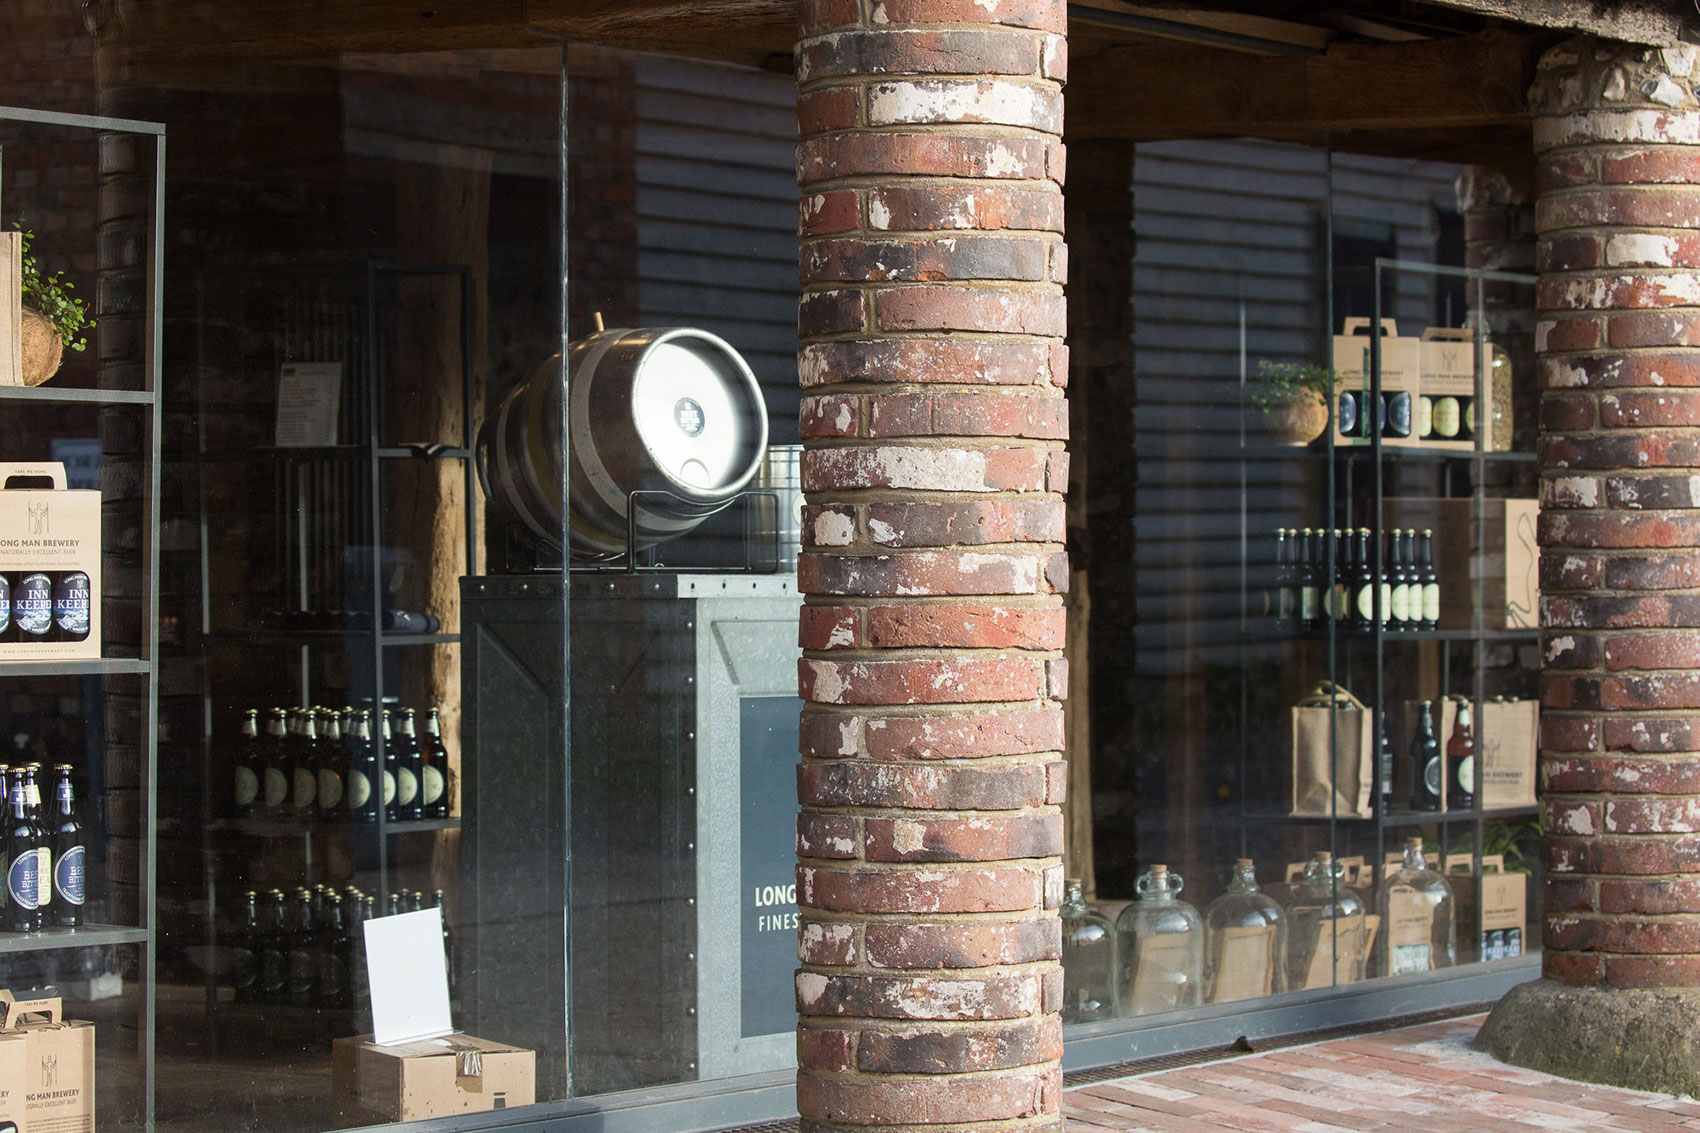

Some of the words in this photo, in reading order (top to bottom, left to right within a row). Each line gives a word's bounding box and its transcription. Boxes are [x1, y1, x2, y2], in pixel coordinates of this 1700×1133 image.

[0, 539, 19, 547] ONG
[21, 539, 41, 547] MAN
[43, 539, 80, 547] BREWERY
[28, 589, 49, 599] INN
[69, 589, 89, 599] INN
[16, 599, 52, 609] KEEPE
[23, 870, 38, 880] BES
[70, 866, 85, 875] BES
[755, 884, 797, 907] LONG
[758, 912, 799, 932] FINES
[36, 1092, 51, 1100] MAN
[52, 1089, 80, 1099] BREWERY
